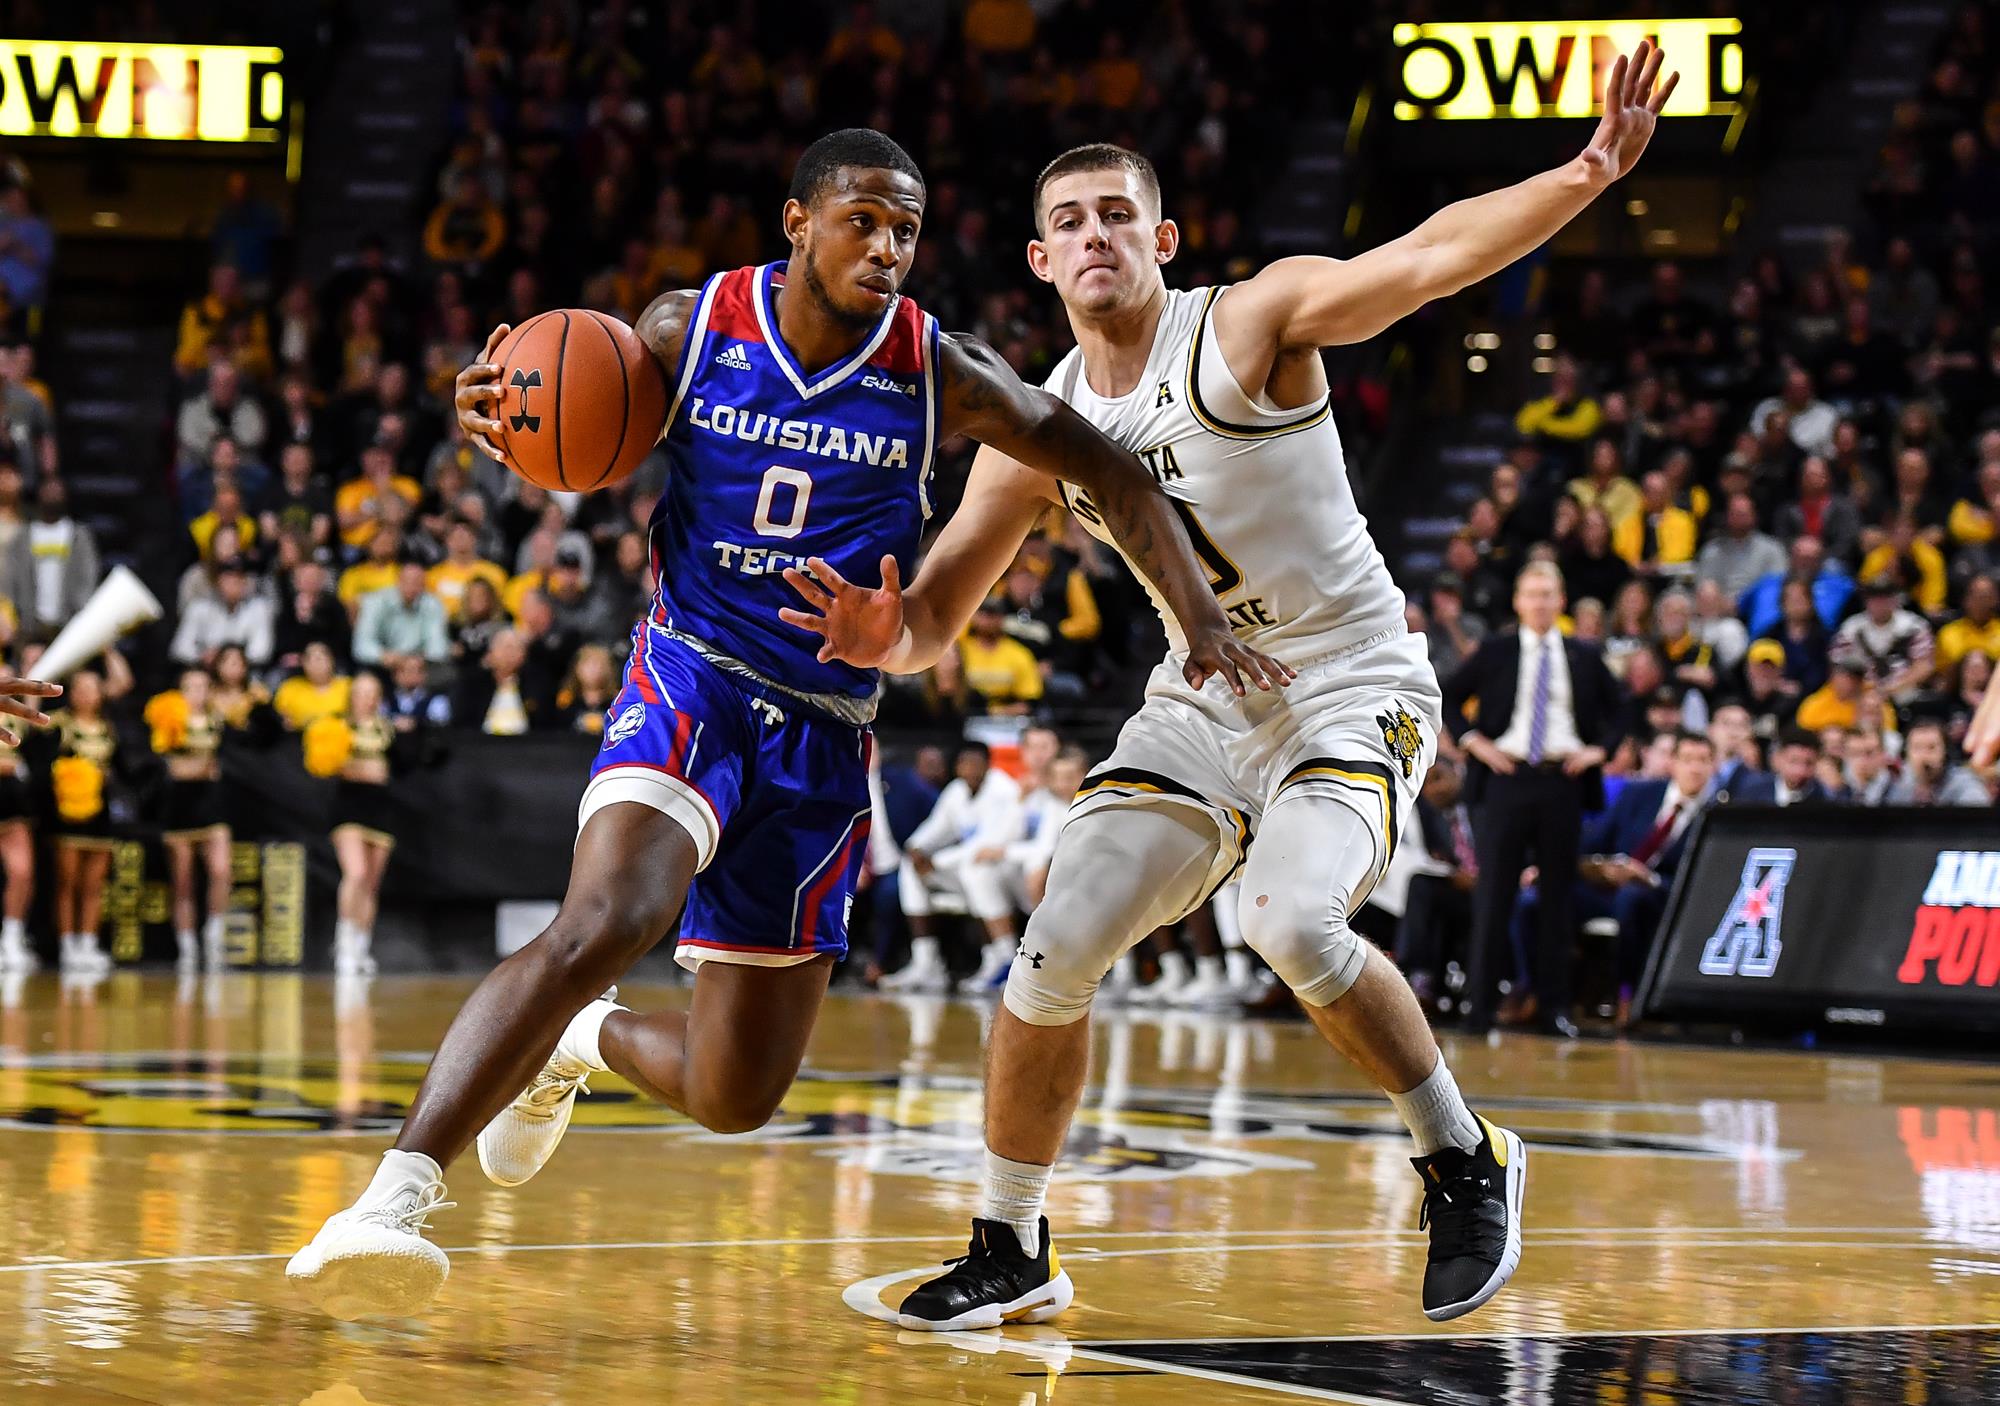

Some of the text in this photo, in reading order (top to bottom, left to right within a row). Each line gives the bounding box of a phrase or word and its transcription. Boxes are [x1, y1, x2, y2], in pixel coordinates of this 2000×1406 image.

[715, 355, 752, 371] adidas
[688, 397, 908, 469] LOUISIANA
[752, 464, 813, 539] 0
